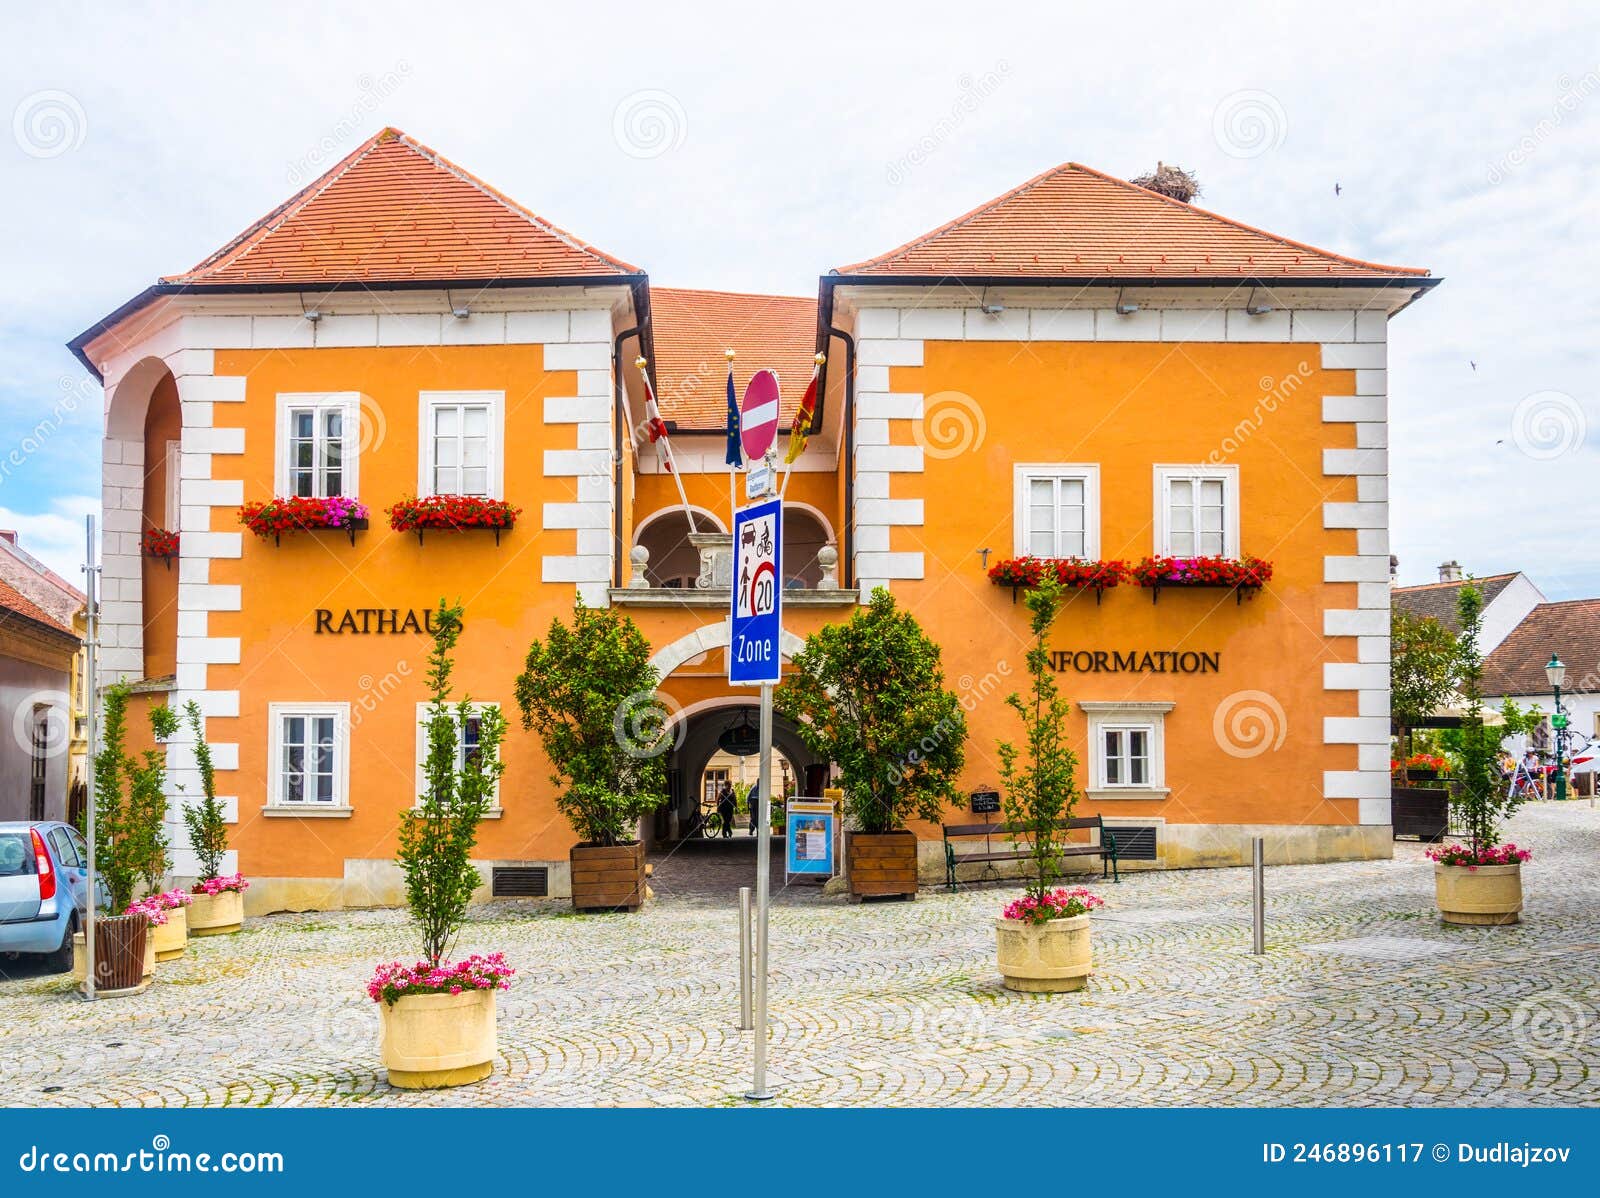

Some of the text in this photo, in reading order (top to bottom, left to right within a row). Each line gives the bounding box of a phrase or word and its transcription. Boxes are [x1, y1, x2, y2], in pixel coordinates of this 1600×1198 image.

[757, 580, 772, 612] 20
[738, 634, 771, 663] Zone
[1030, 650, 1220, 673] NFORMATION
